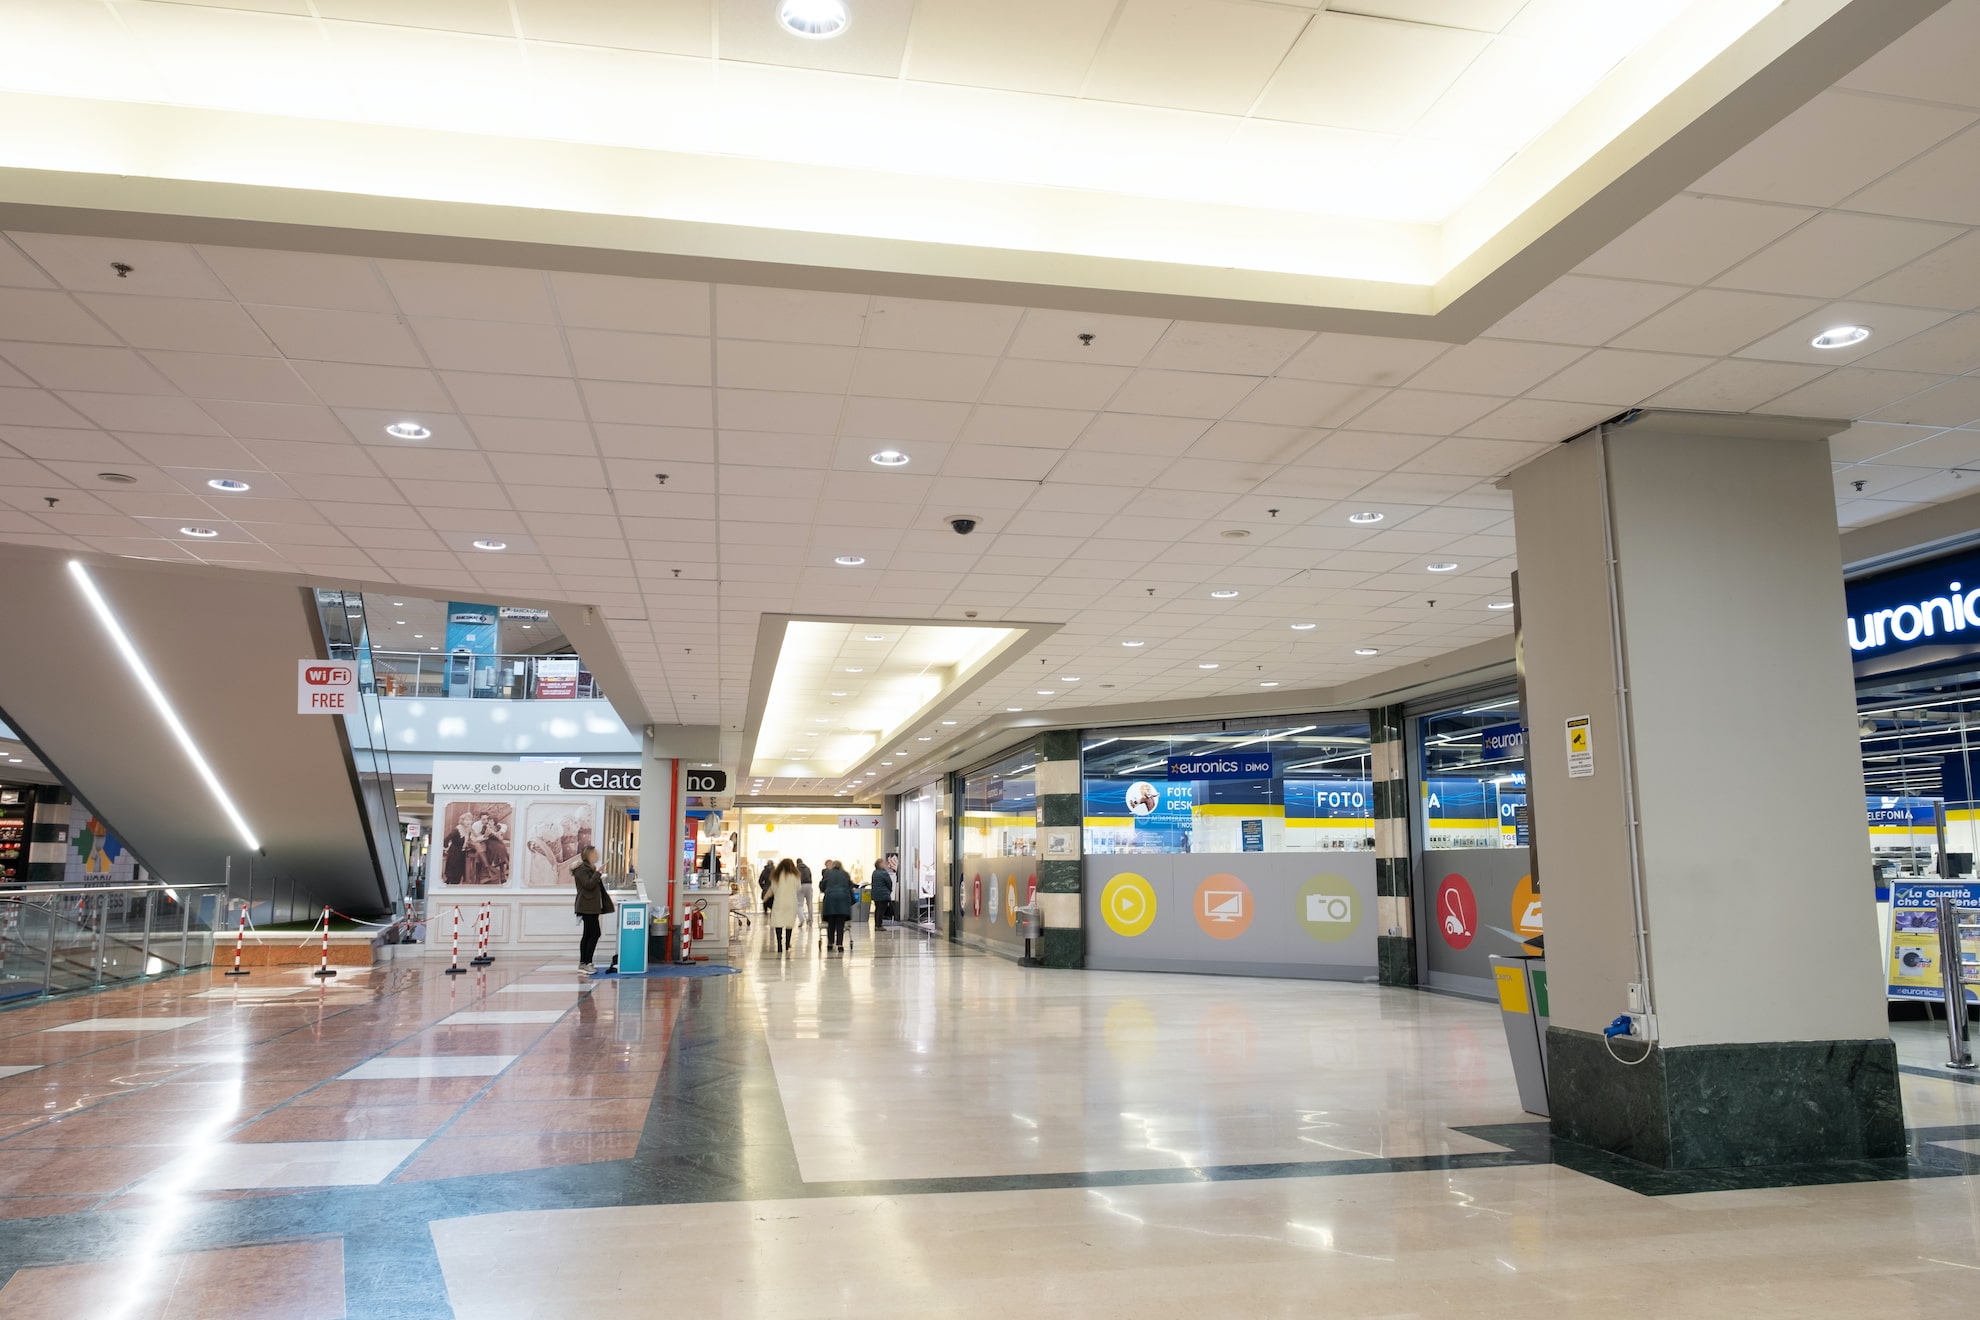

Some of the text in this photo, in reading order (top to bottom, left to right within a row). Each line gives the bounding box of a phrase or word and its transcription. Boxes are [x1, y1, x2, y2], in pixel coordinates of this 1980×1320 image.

[312, 693, 345, 708] FREE
[1179, 759, 1239, 774] euronics
[570, 769, 642, 789] Gelato
[442, 781, 550, 793] www.gelatobuono.it
[1167, 800, 1193, 811] DESK
[1317, 791, 1364, 808] FOTO
[1909, 888, 1971, 899] La Qualità
[1896, 898, 1980, 907] che coene!
[1901, 988, 1939, 997] euronics
